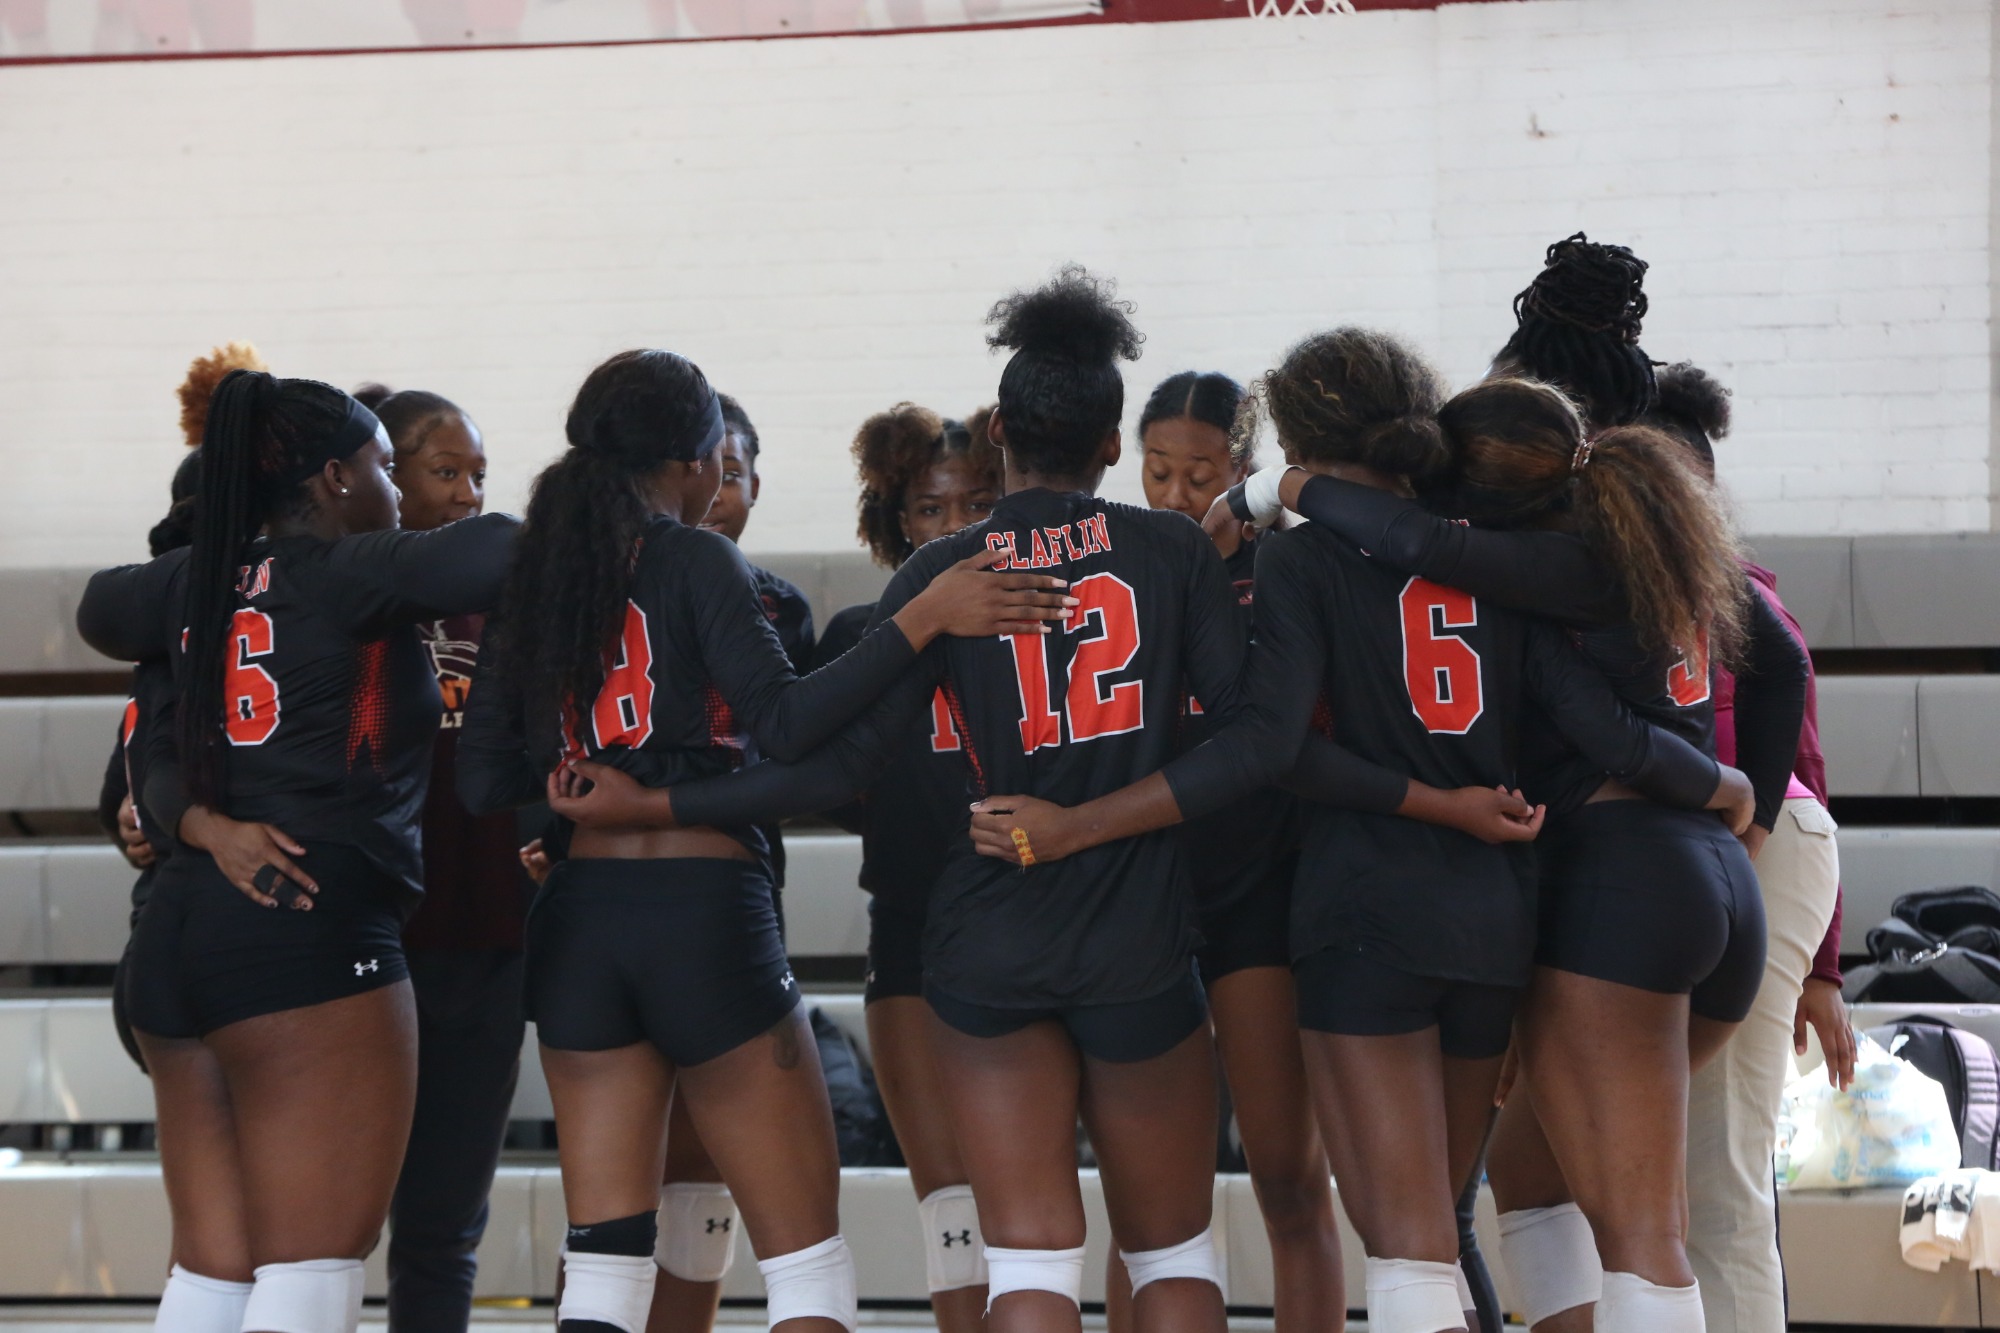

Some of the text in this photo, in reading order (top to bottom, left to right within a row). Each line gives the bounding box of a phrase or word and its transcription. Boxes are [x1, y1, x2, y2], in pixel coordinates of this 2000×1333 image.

[986, 512, 1112, 571] CLAFLIN
[1000, 571, 1144, 756] 12
[1399, 574, 1484, 735] 6
